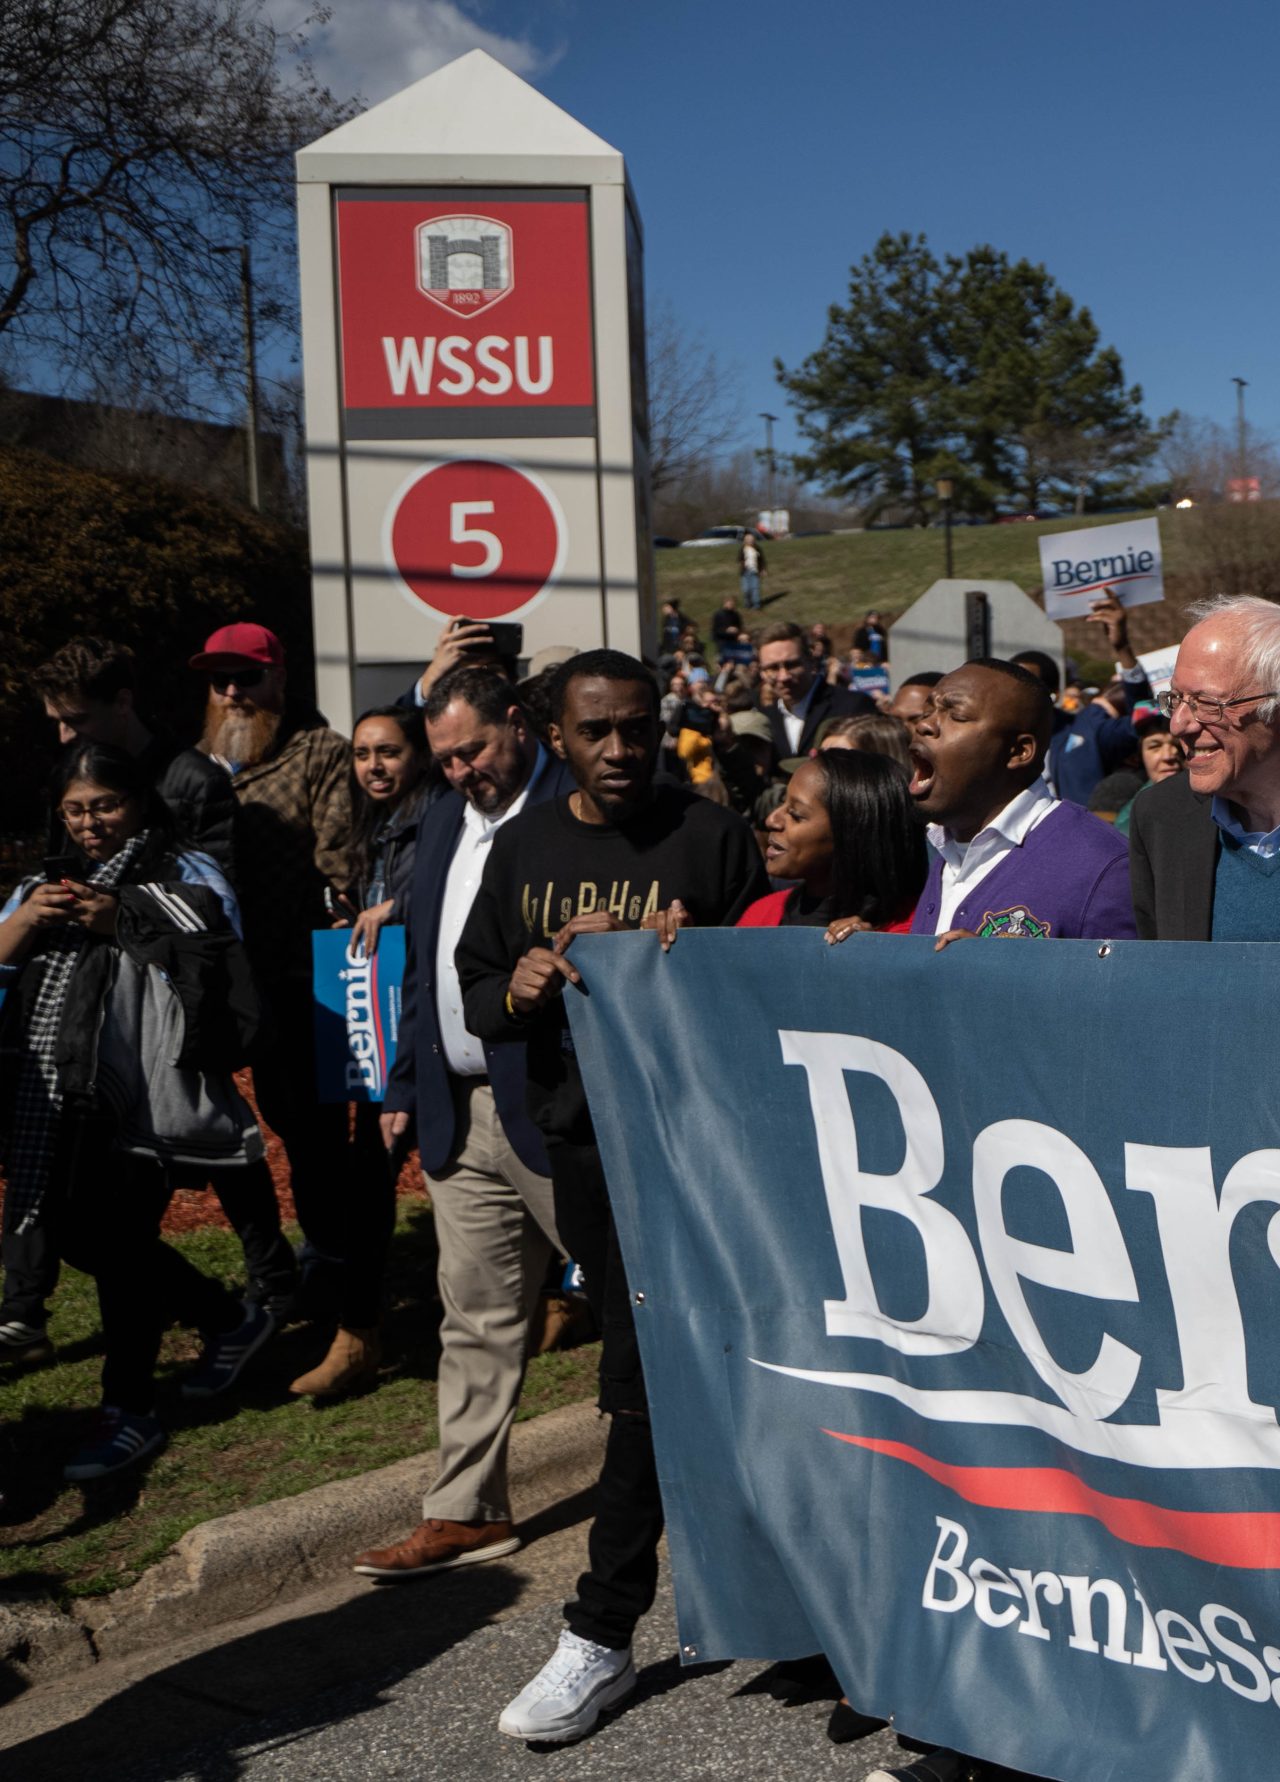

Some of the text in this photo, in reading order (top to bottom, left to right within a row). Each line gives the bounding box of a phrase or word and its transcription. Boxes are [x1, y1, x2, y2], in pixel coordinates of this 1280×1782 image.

[382, 336, 553, 395] WSSU
[450, 500, 503, 578] 5
[1052, 546, 1154, 588] Bernie
[338, 943, 377, 1090] Bernie
